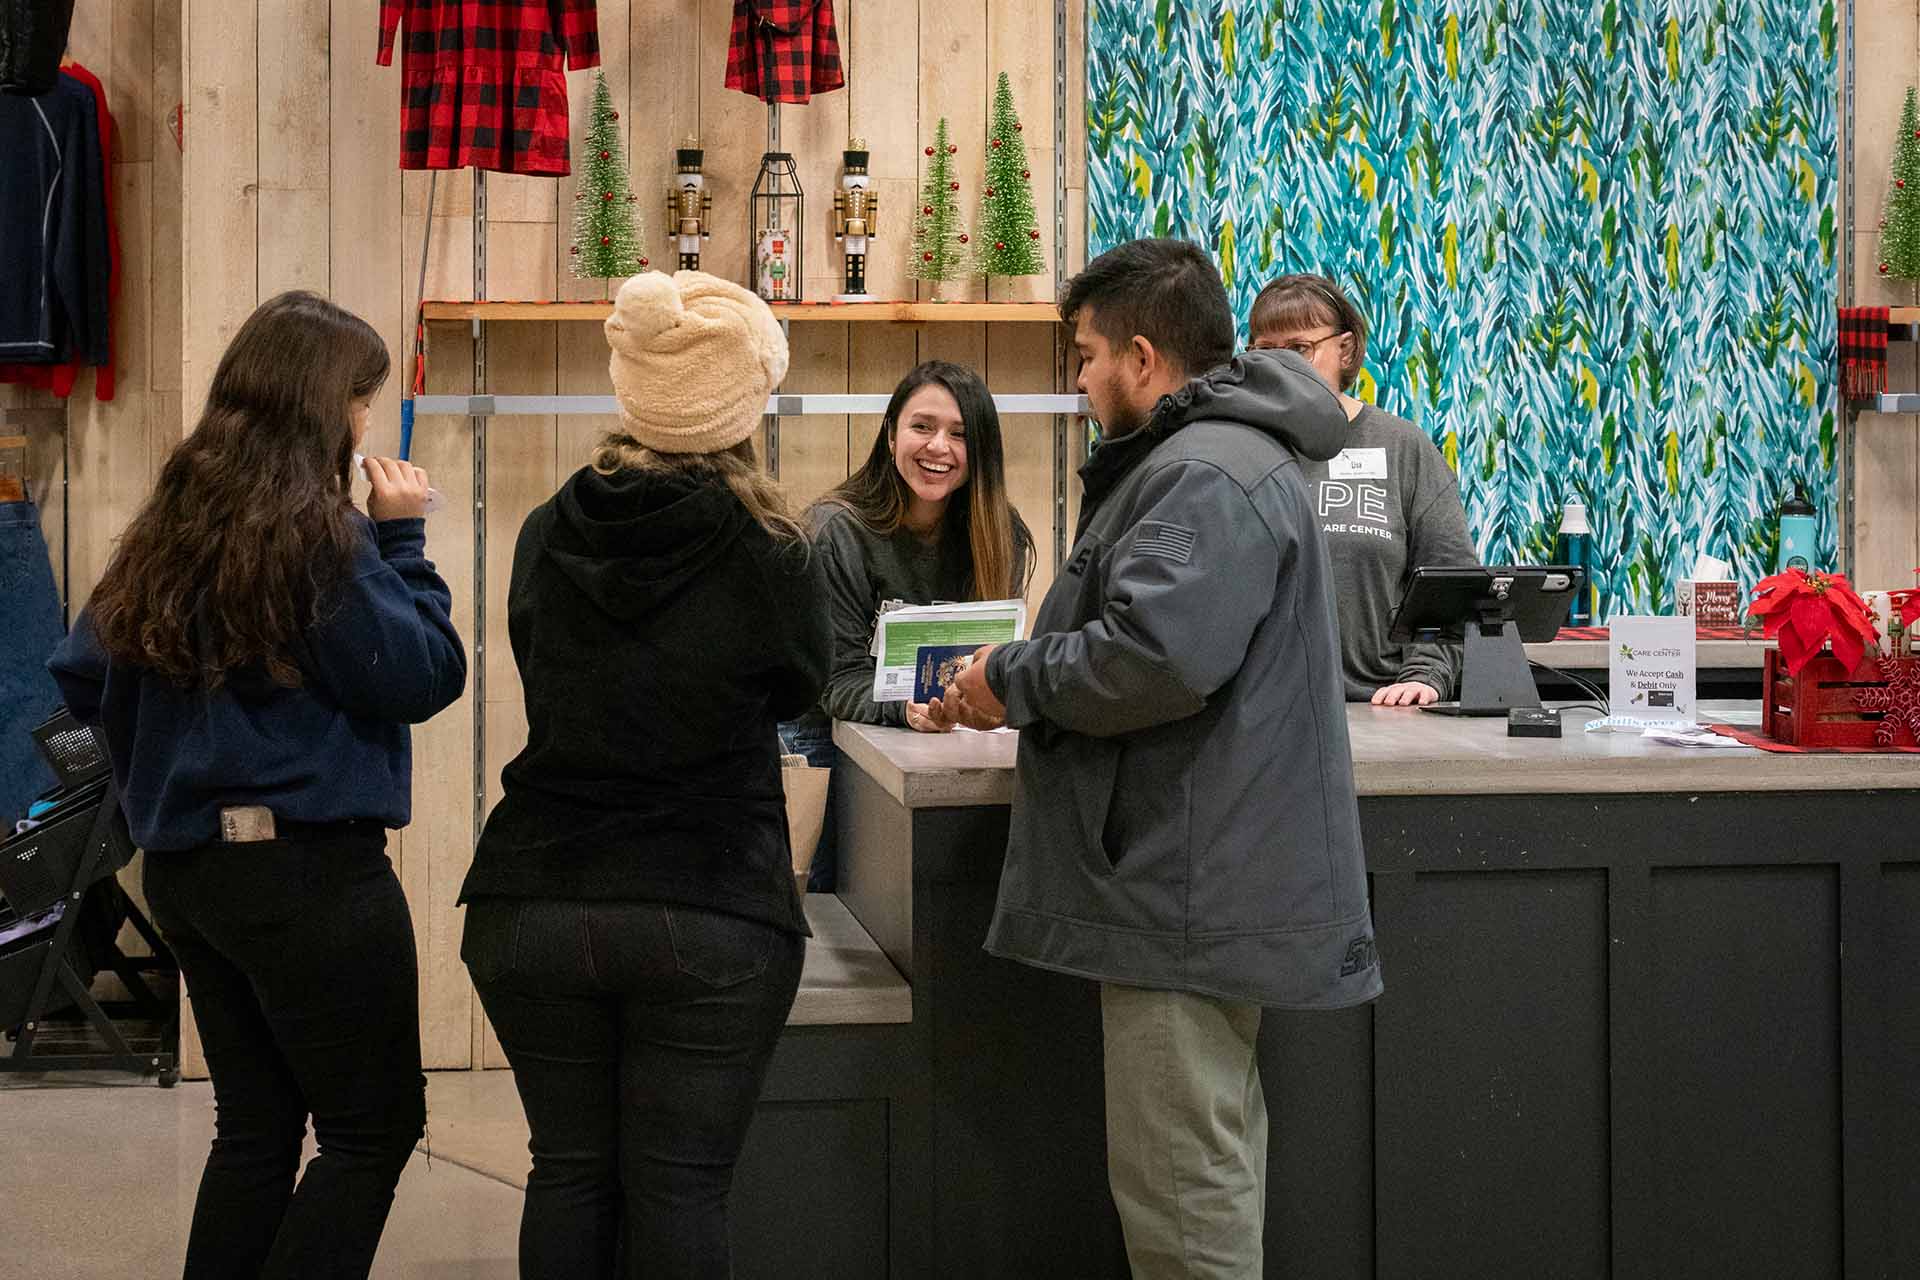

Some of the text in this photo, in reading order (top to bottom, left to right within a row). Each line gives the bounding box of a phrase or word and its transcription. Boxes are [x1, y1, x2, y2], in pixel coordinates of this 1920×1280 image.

[1318, 481, 1388, 524] PE
[1322, 523, 1392, 541] ARE CENTER
[1703, 591, 1730, 605] Merry
[1632, 649, 1651, 657] CARE
[1652, 649, 1681, 657] CENTER
[1626, 669, 1684, 680] We Accept Cash
[1638, 681, 1658, 689] Debit
[1659, 682, 1677, 690] Only
